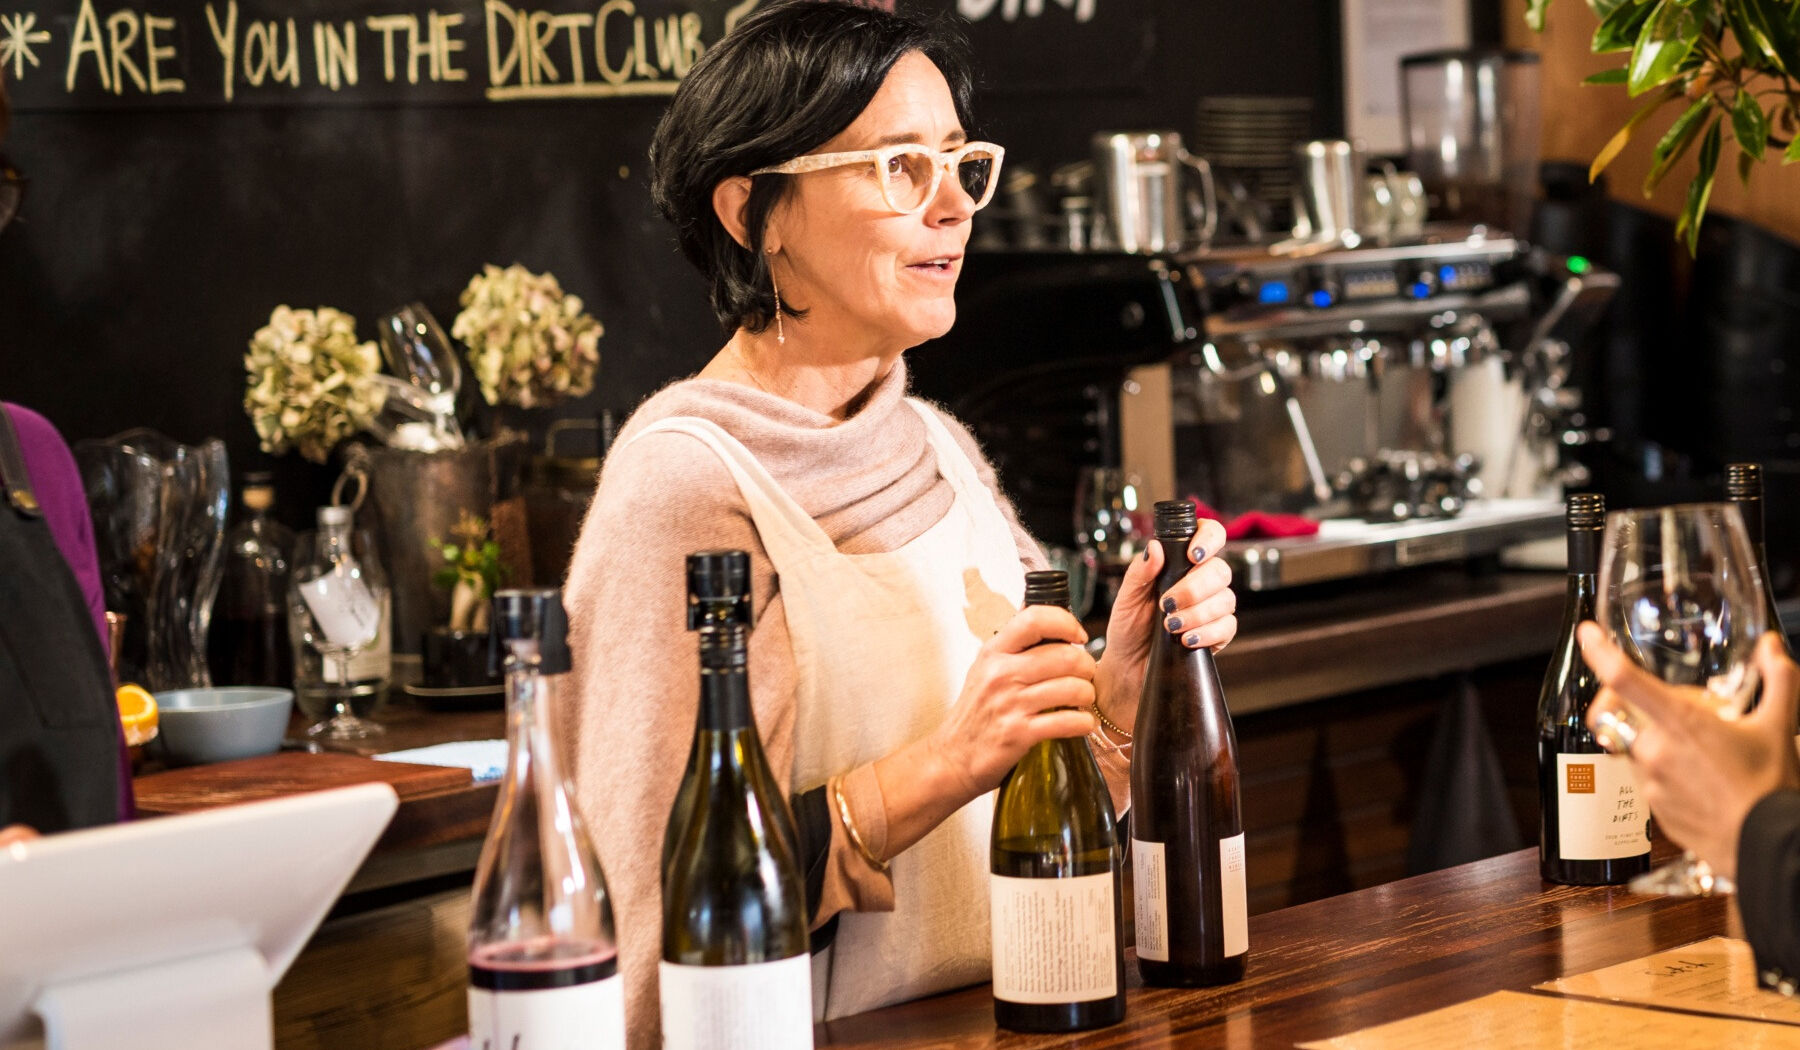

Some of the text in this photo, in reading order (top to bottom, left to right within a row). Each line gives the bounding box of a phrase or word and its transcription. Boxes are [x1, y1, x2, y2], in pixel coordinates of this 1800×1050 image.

[66, 0, 186, 95] ARE
[205, 0, 301, 102] YOU
[313, 20, 358, 91] IN
[366, 9, 468, 84] THE
[485, 0, 594, 86] DIRT
[1620, 786, 1633, 796] ALL
[1617, 799, 1634, 810] THE
